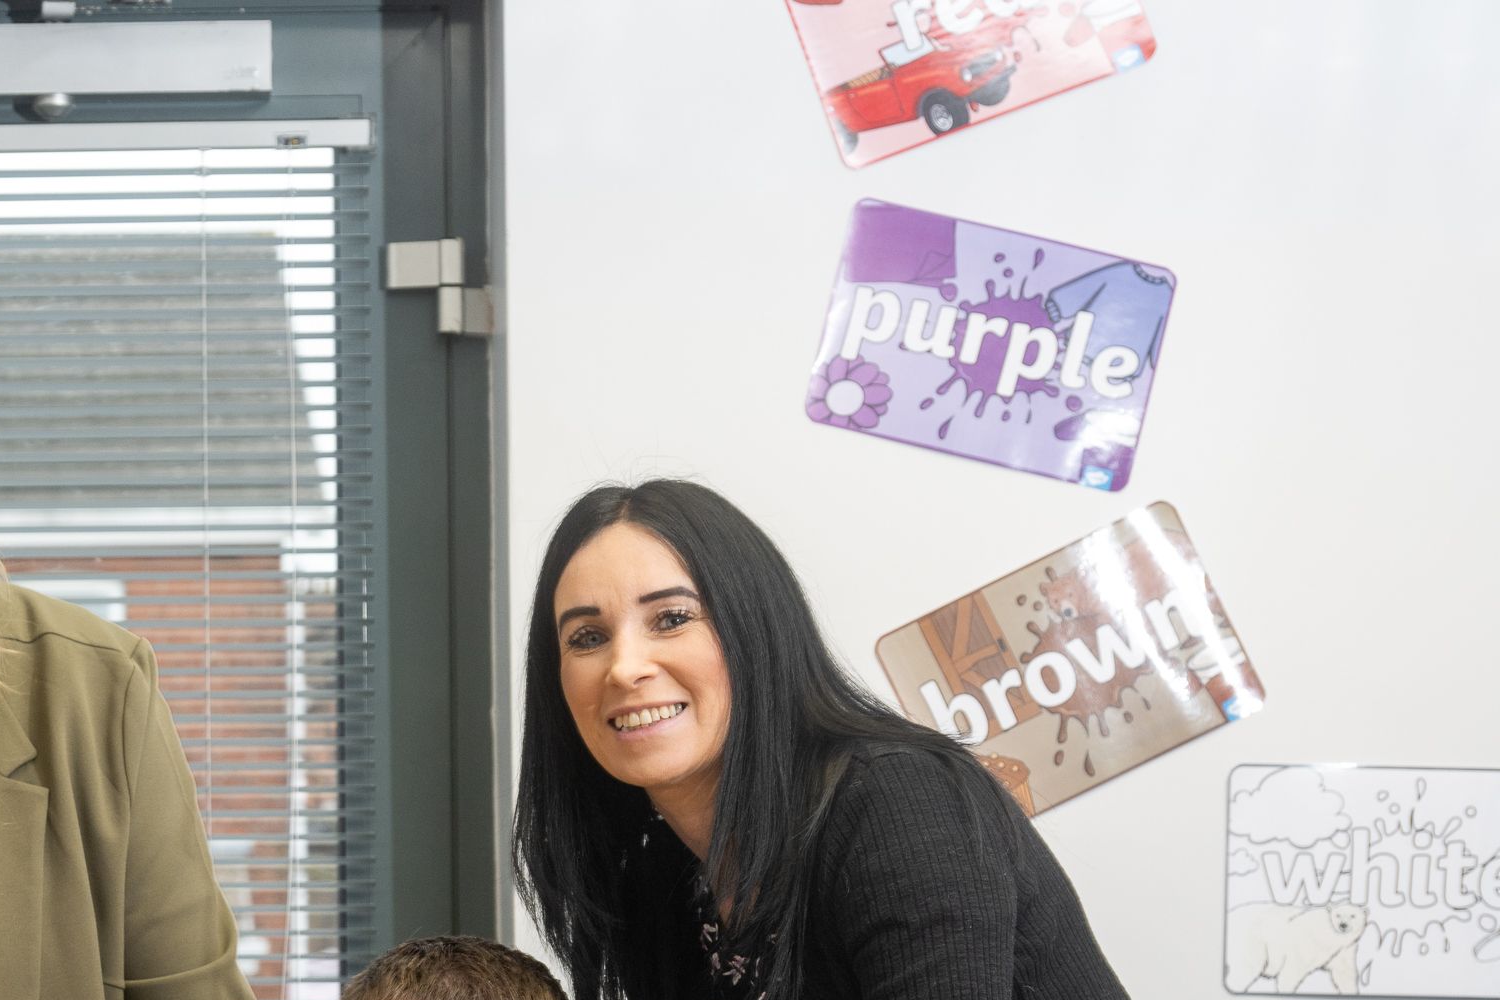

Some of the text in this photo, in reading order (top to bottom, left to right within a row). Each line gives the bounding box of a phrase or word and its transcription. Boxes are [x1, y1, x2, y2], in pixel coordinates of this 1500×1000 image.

[891, 0, 1044, 51] re
[840, 285, 1141, 398] purple
[919, 588, 1214, 746] brown
